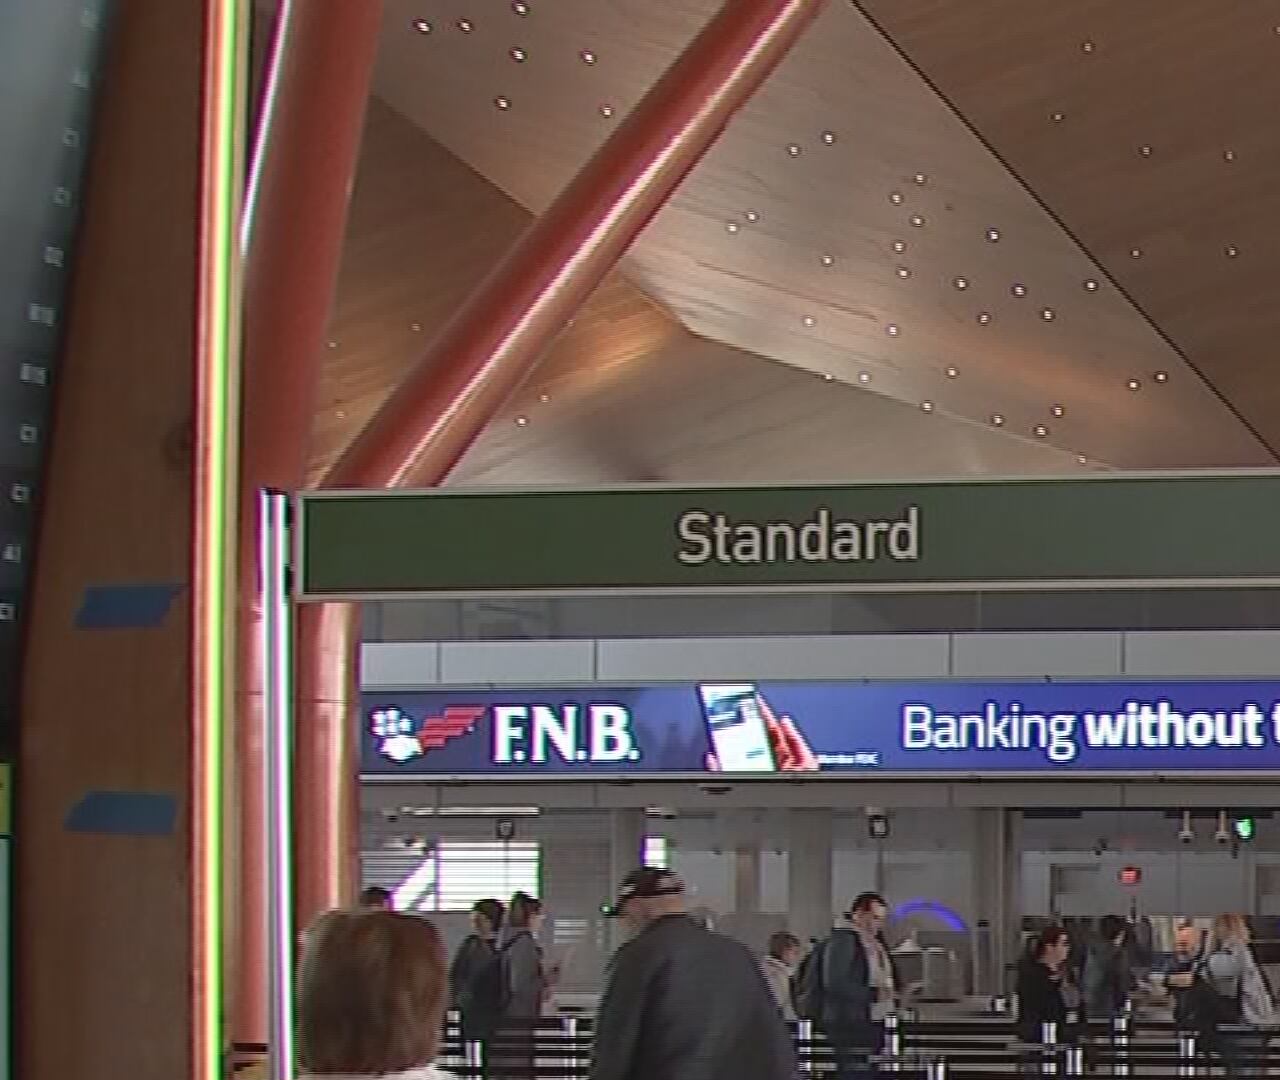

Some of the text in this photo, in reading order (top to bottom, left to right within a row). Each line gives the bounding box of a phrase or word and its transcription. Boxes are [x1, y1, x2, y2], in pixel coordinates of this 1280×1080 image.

[677, 507, 918, 563] Standard
[494, 703, 640, 763] F.N.B.
[904, 703, 1077, 762] Banking
[1084, 702, 1264, 747] without
